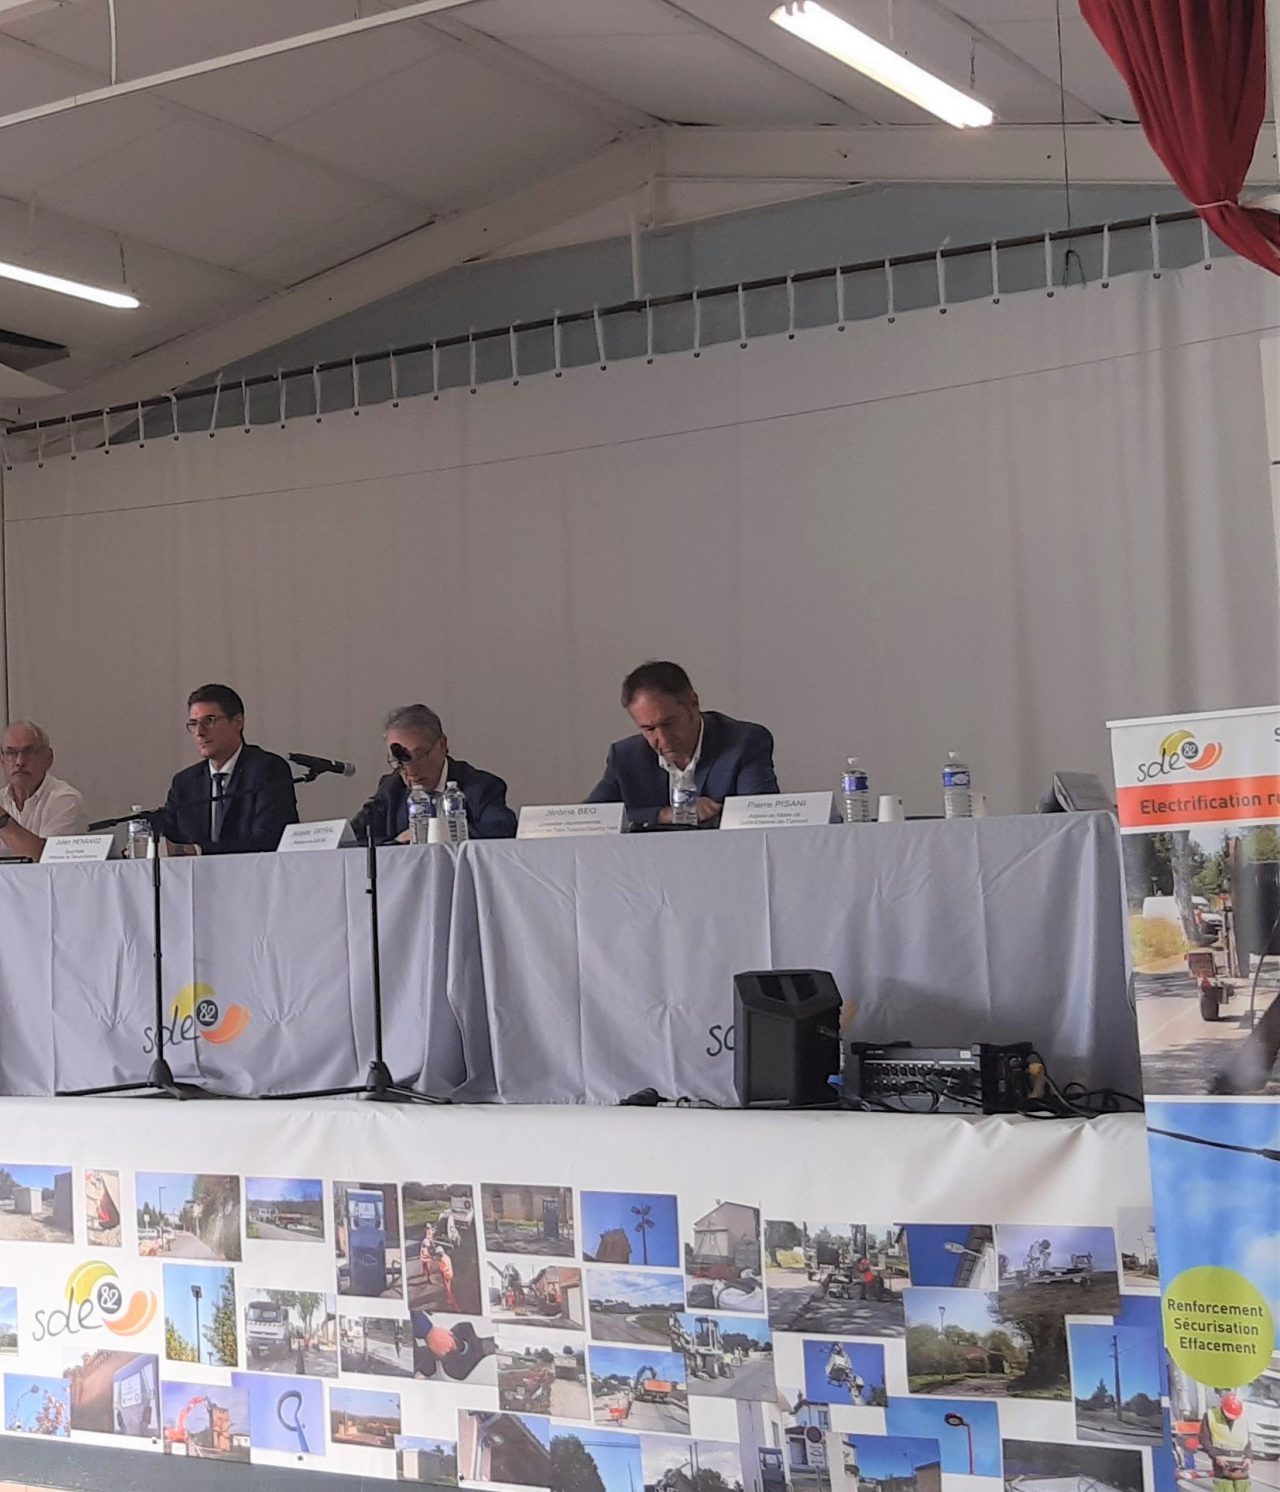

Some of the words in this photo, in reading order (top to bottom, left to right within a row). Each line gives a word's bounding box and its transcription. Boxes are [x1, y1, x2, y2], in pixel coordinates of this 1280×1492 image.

[1137, 748, 1186, 782] sde
[1182, 742, 1197, 757] 82
[774, 799, 807, 808] PISANI
[1140, 793, 1262, 814] Electrification
[199, 1002, 216, 1022] 82
[33, 1285, 104, 1342] sde
[100, 1285, 119, 1310] 82
[1167, 1298, 1264, 1317] Renforcement
[1173, 1317, 1259, 1336] Sécurisation
[1179, 1336, 1257, 1355] Effacement
